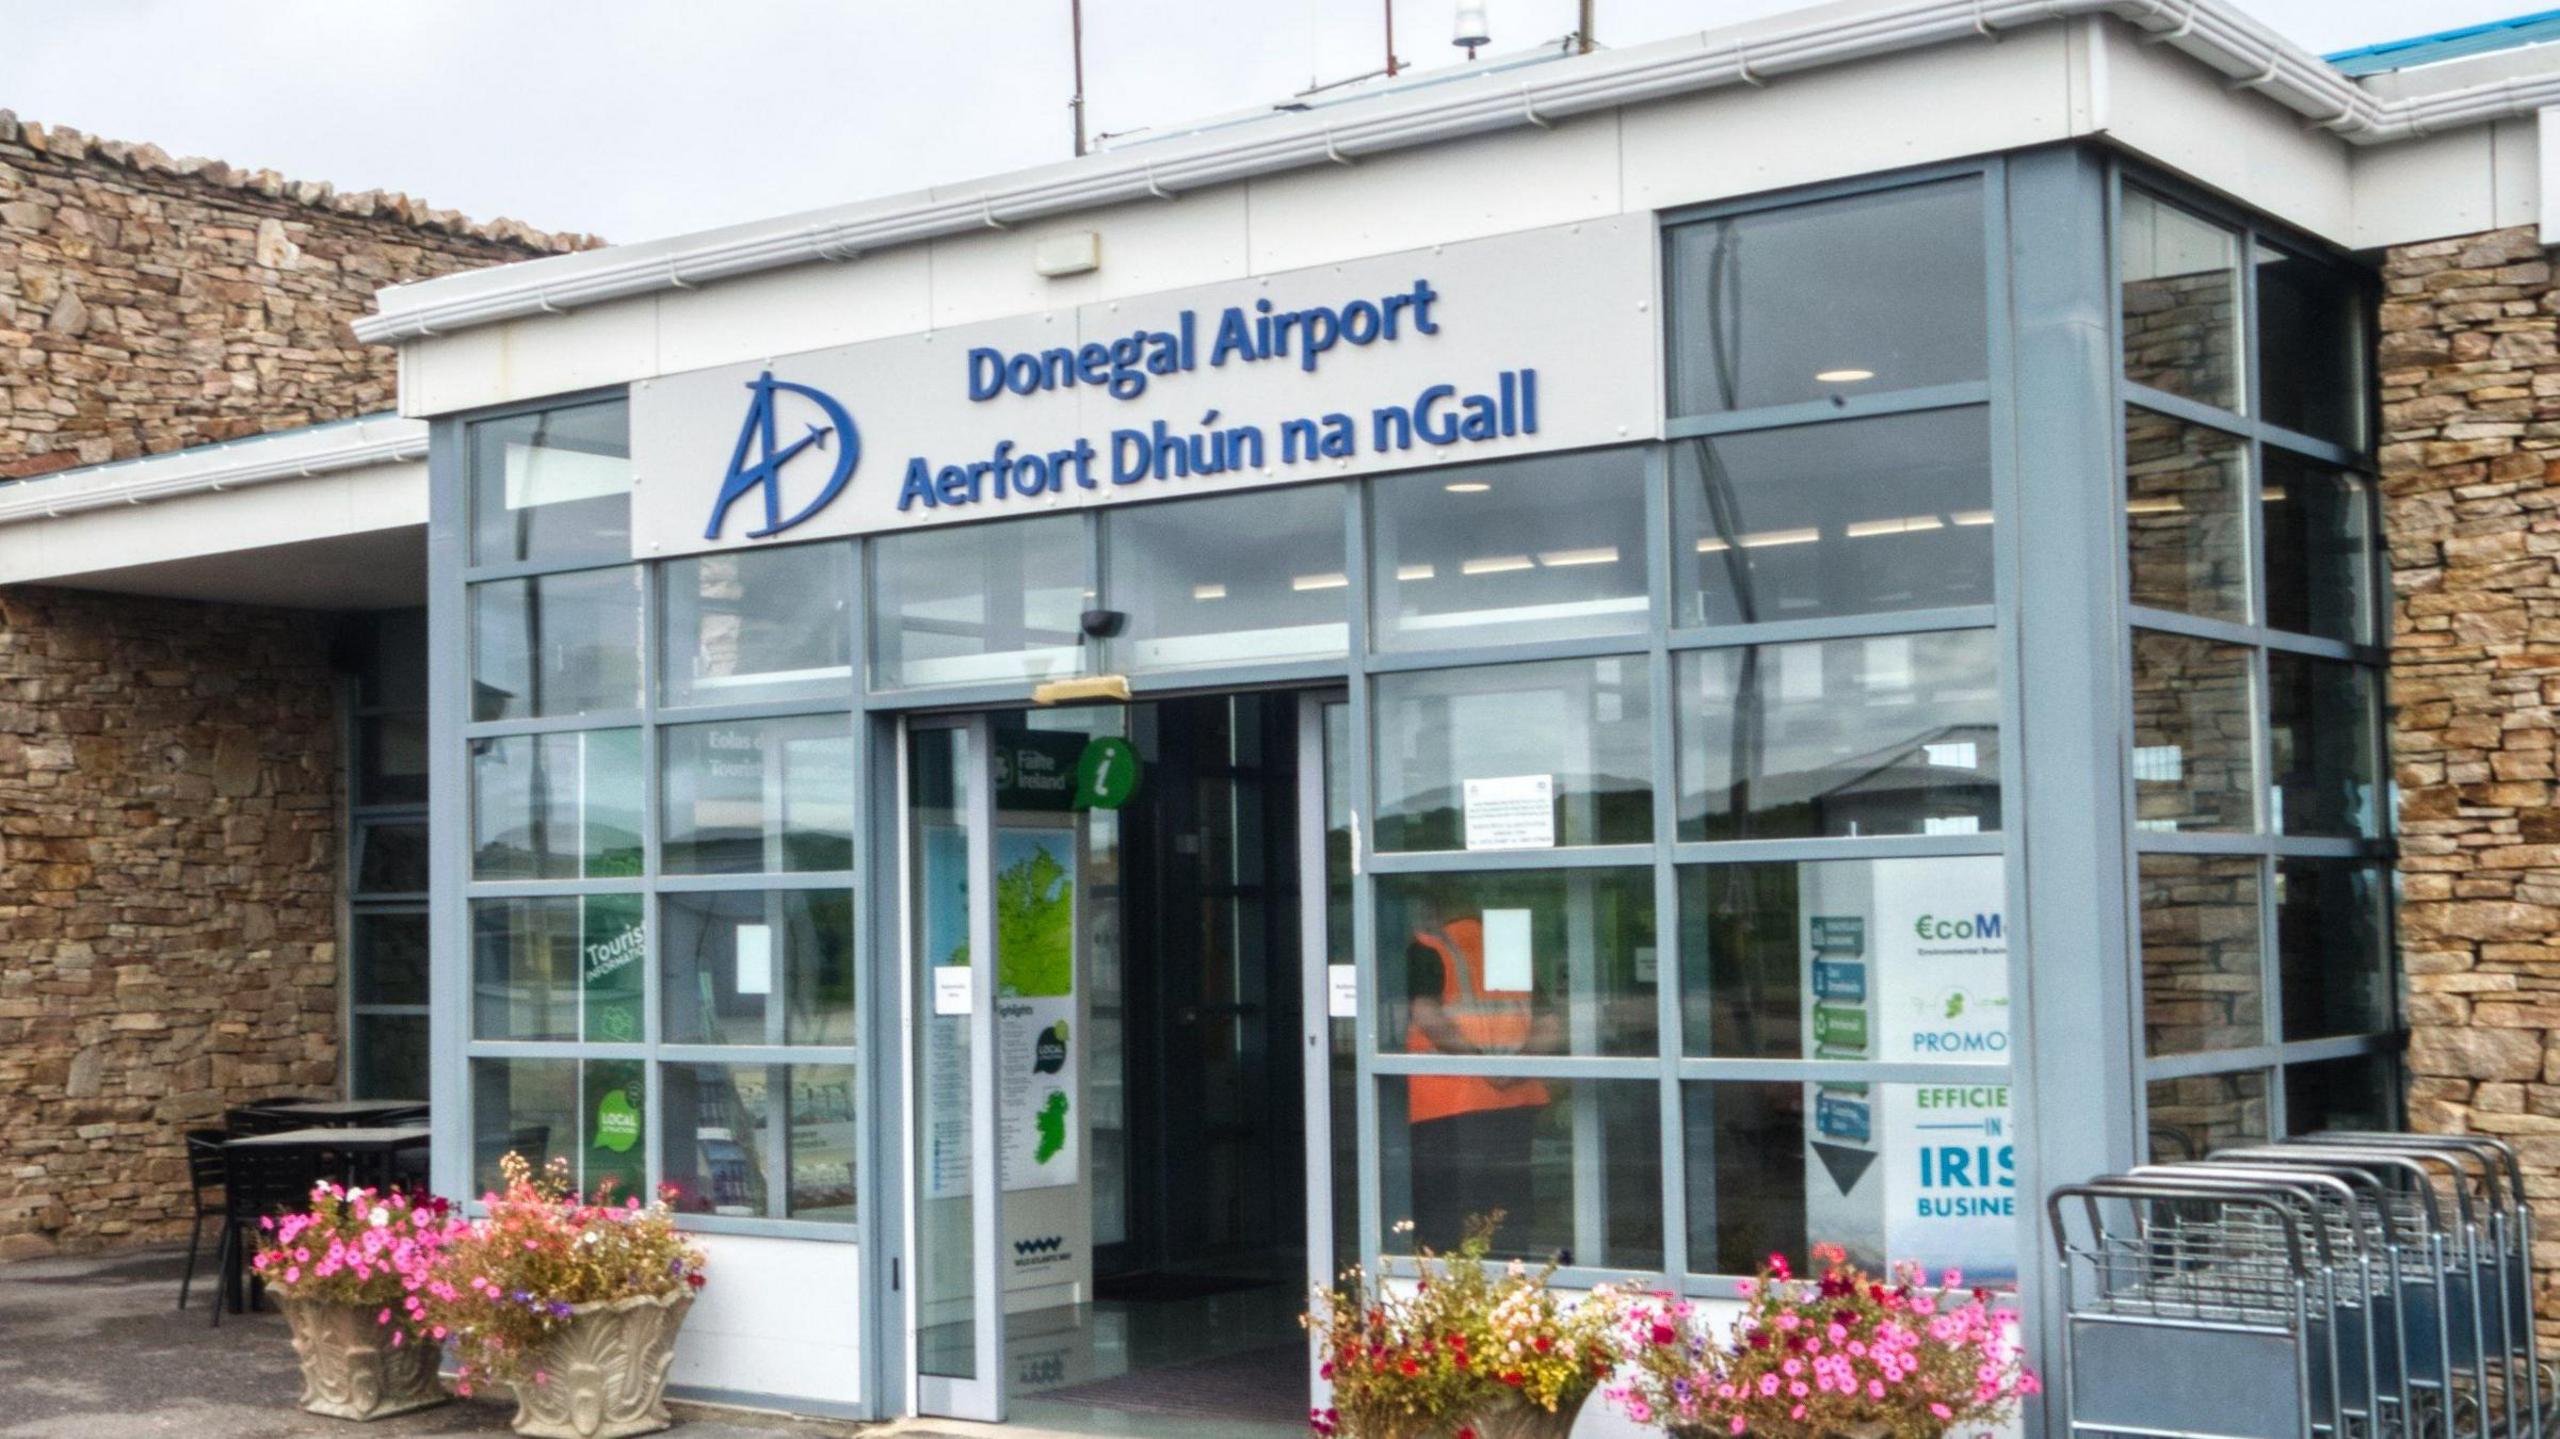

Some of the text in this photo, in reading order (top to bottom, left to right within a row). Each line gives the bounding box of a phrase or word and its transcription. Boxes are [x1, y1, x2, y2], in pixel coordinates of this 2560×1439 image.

[970, 280, 1437, 399] Donegal Airport
[900, 369, 1538, 511] Aerfort Dhún na nGall
[1916, 913, 2006, 940] €coM
[1913, 1031, 2007, 1052] PROMO
[1917, 1087, 2008, 1108] EFFICIE
[601, 1112, 638, 1127] LOCAL
[1985, 1117, 2002, 1137] IN
[1918, 1196, 2014, 1217] BUSINE
